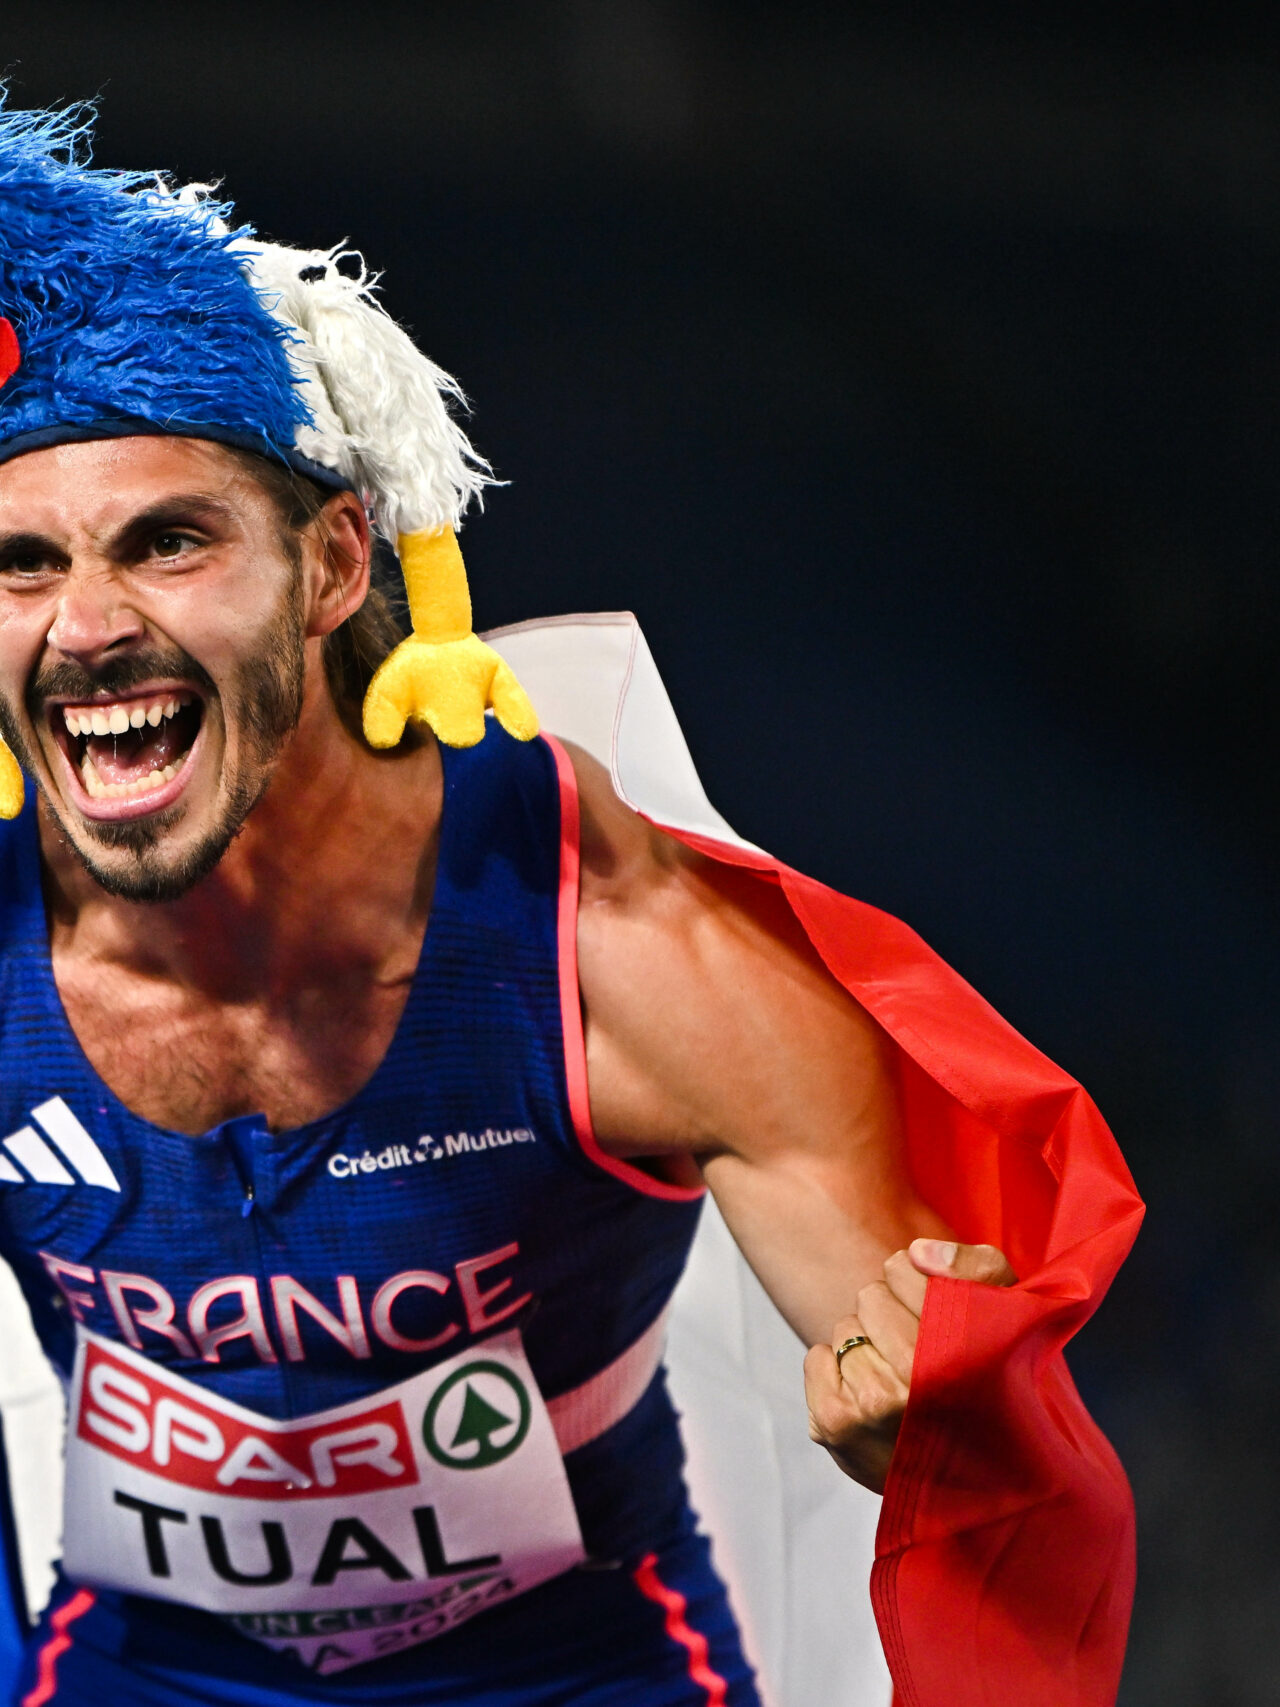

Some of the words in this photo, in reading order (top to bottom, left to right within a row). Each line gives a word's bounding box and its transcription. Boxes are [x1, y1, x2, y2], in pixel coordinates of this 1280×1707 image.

[327, 1145, 413, 1178] Crédit
[444, 1127, 536, 1156] Mutuel
[39, 1241, 533, 1363] FRANCE
[85, 1362, 406, 1489] SPAR
[114, 1490, 502, 1588] TUAL
